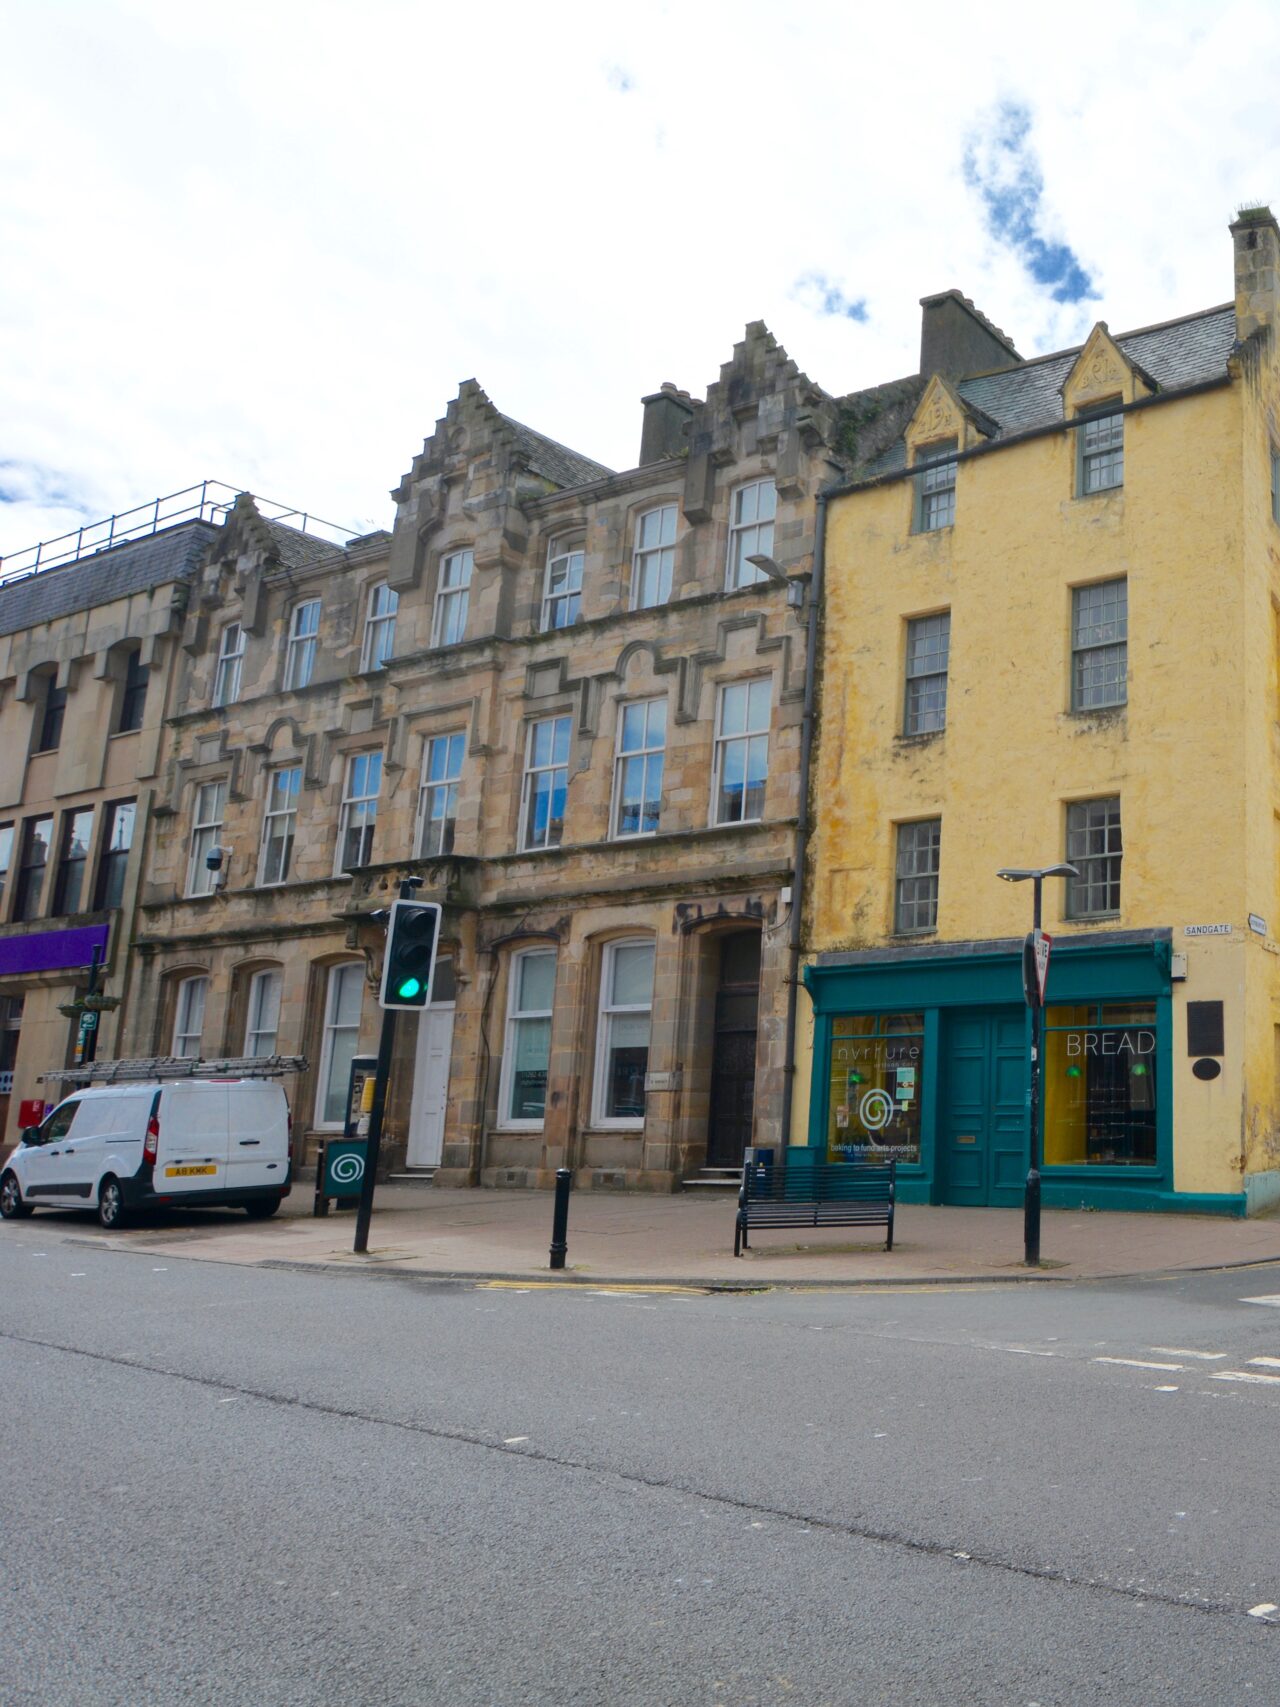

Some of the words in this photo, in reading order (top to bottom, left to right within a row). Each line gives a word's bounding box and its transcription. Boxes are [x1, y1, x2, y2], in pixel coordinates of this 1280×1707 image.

[1186, 924, 1229, 934] SANDGATE
[1066, 1031, 1156, 1056] BREAD
[831, 1144, 852, 1154] baking
[853, 1144, 860, 1152] to
[861, 1144, 875, 1152] fund
[890, 1144, 917, 1154] projects
